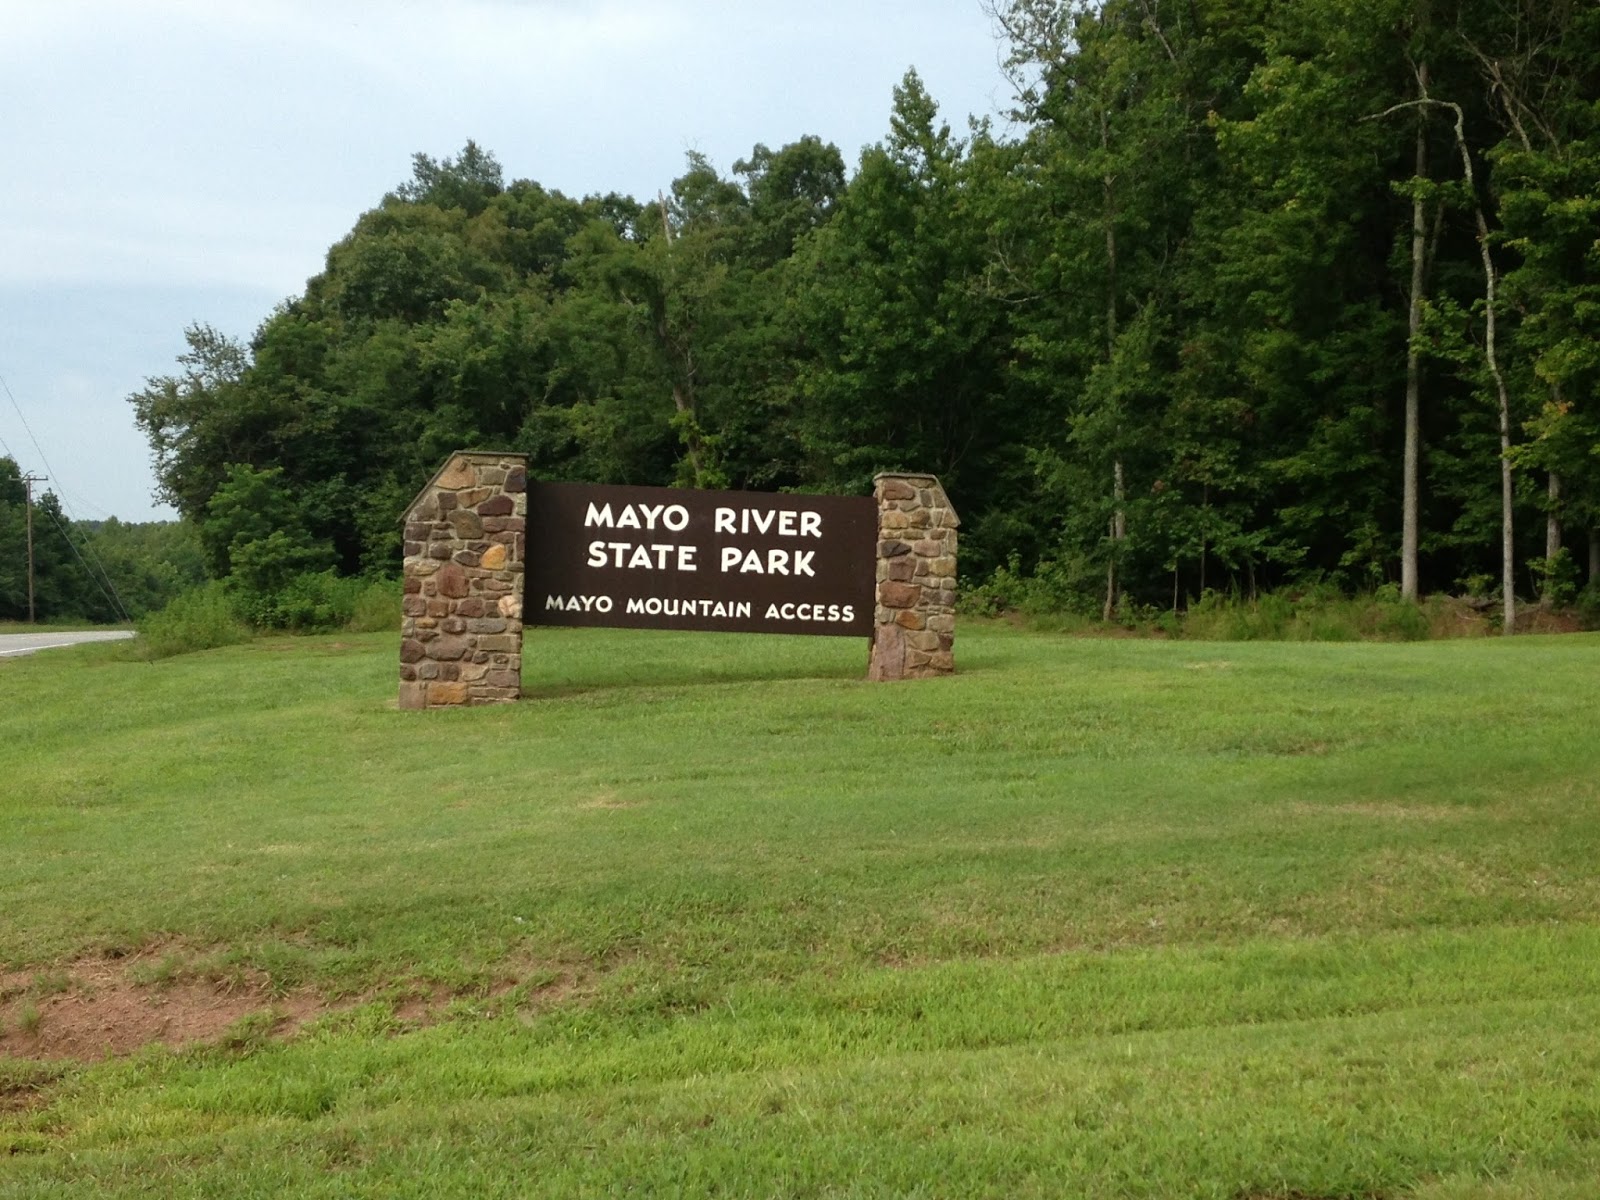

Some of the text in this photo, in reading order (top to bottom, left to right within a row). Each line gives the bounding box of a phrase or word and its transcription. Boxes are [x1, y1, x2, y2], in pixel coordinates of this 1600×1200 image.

[584, 501, 823, 538] MAYO RIVER
[587, 540, 816, 578] STATE PARK
[545, 595, 855, 623] MAYO MOUNTAIN ACCESS
